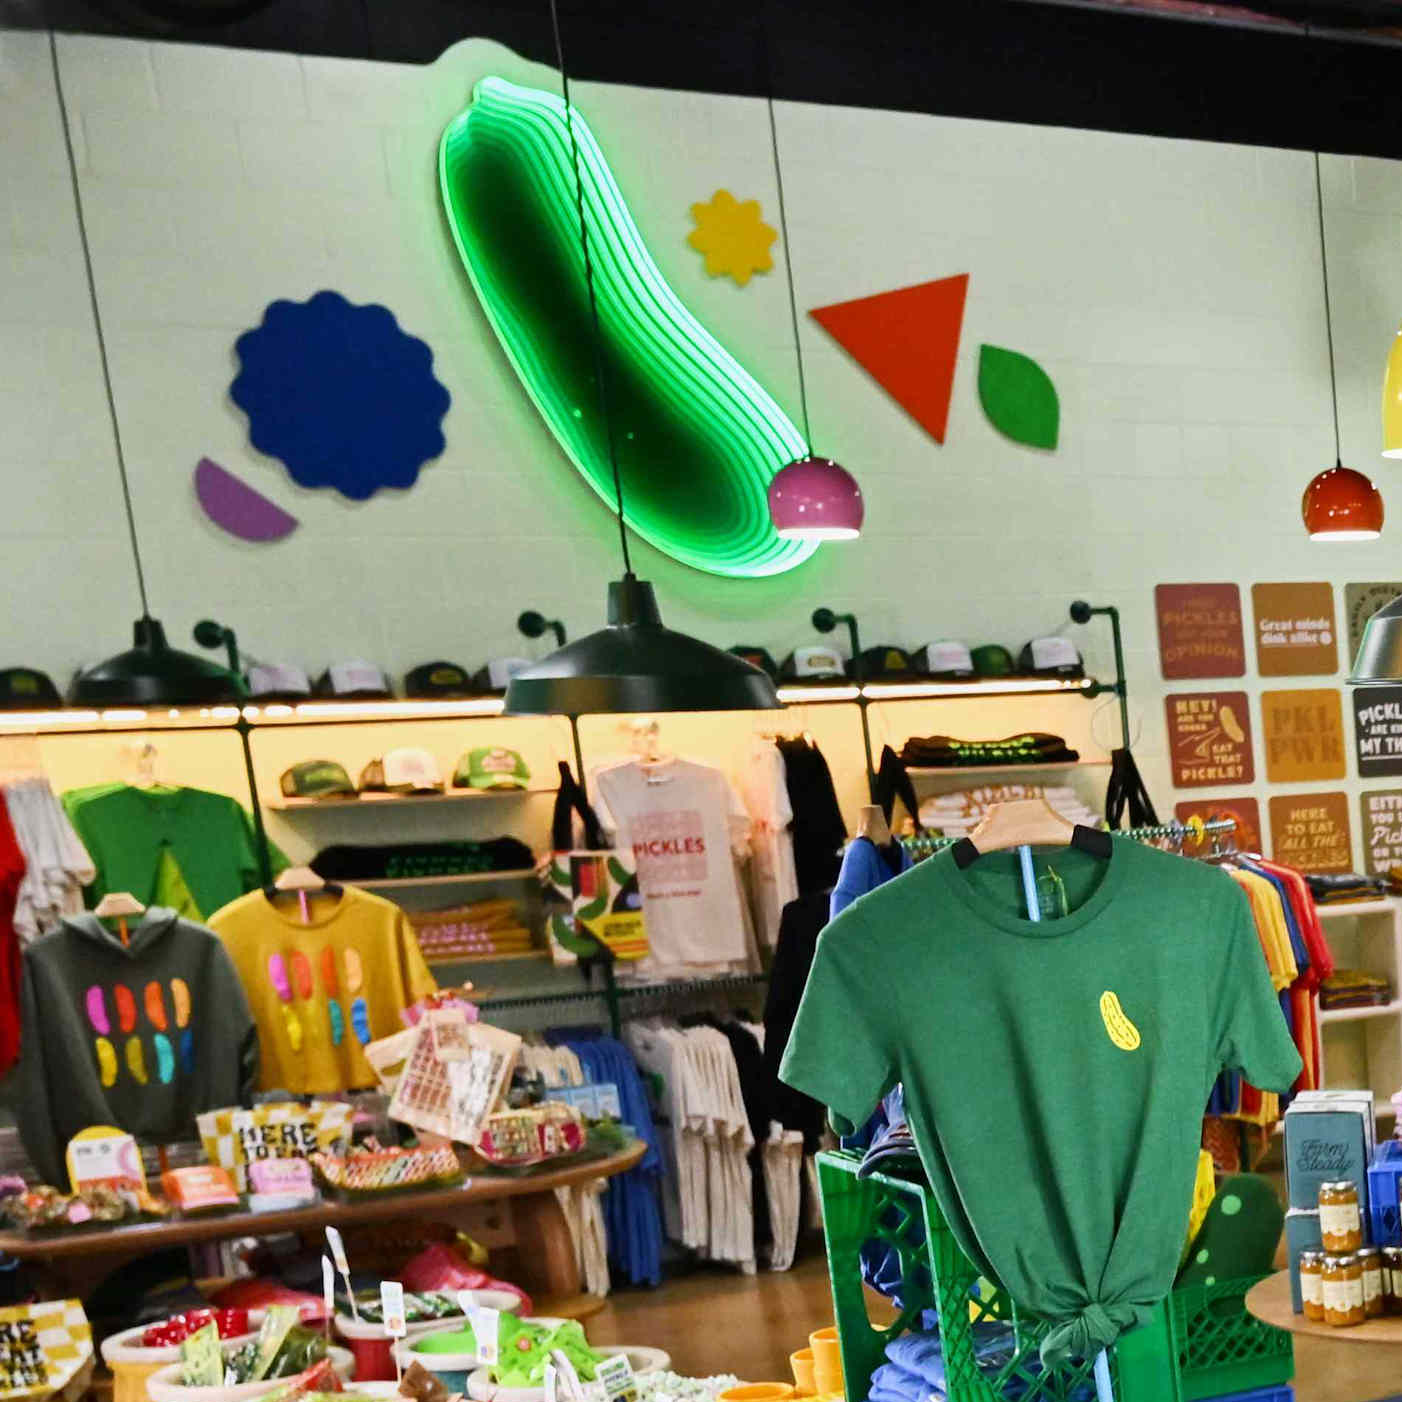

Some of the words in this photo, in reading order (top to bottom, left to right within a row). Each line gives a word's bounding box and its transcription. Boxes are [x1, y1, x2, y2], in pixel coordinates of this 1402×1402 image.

[1175, 699, 1217, 714] HEY!
[1360, 737, 1383, 754] MY
[1181, 766, 1244, 781] PICKLE?
[1370, 812, 1396, 824] YOU
[632, 836, 706, 857] PICKLES
